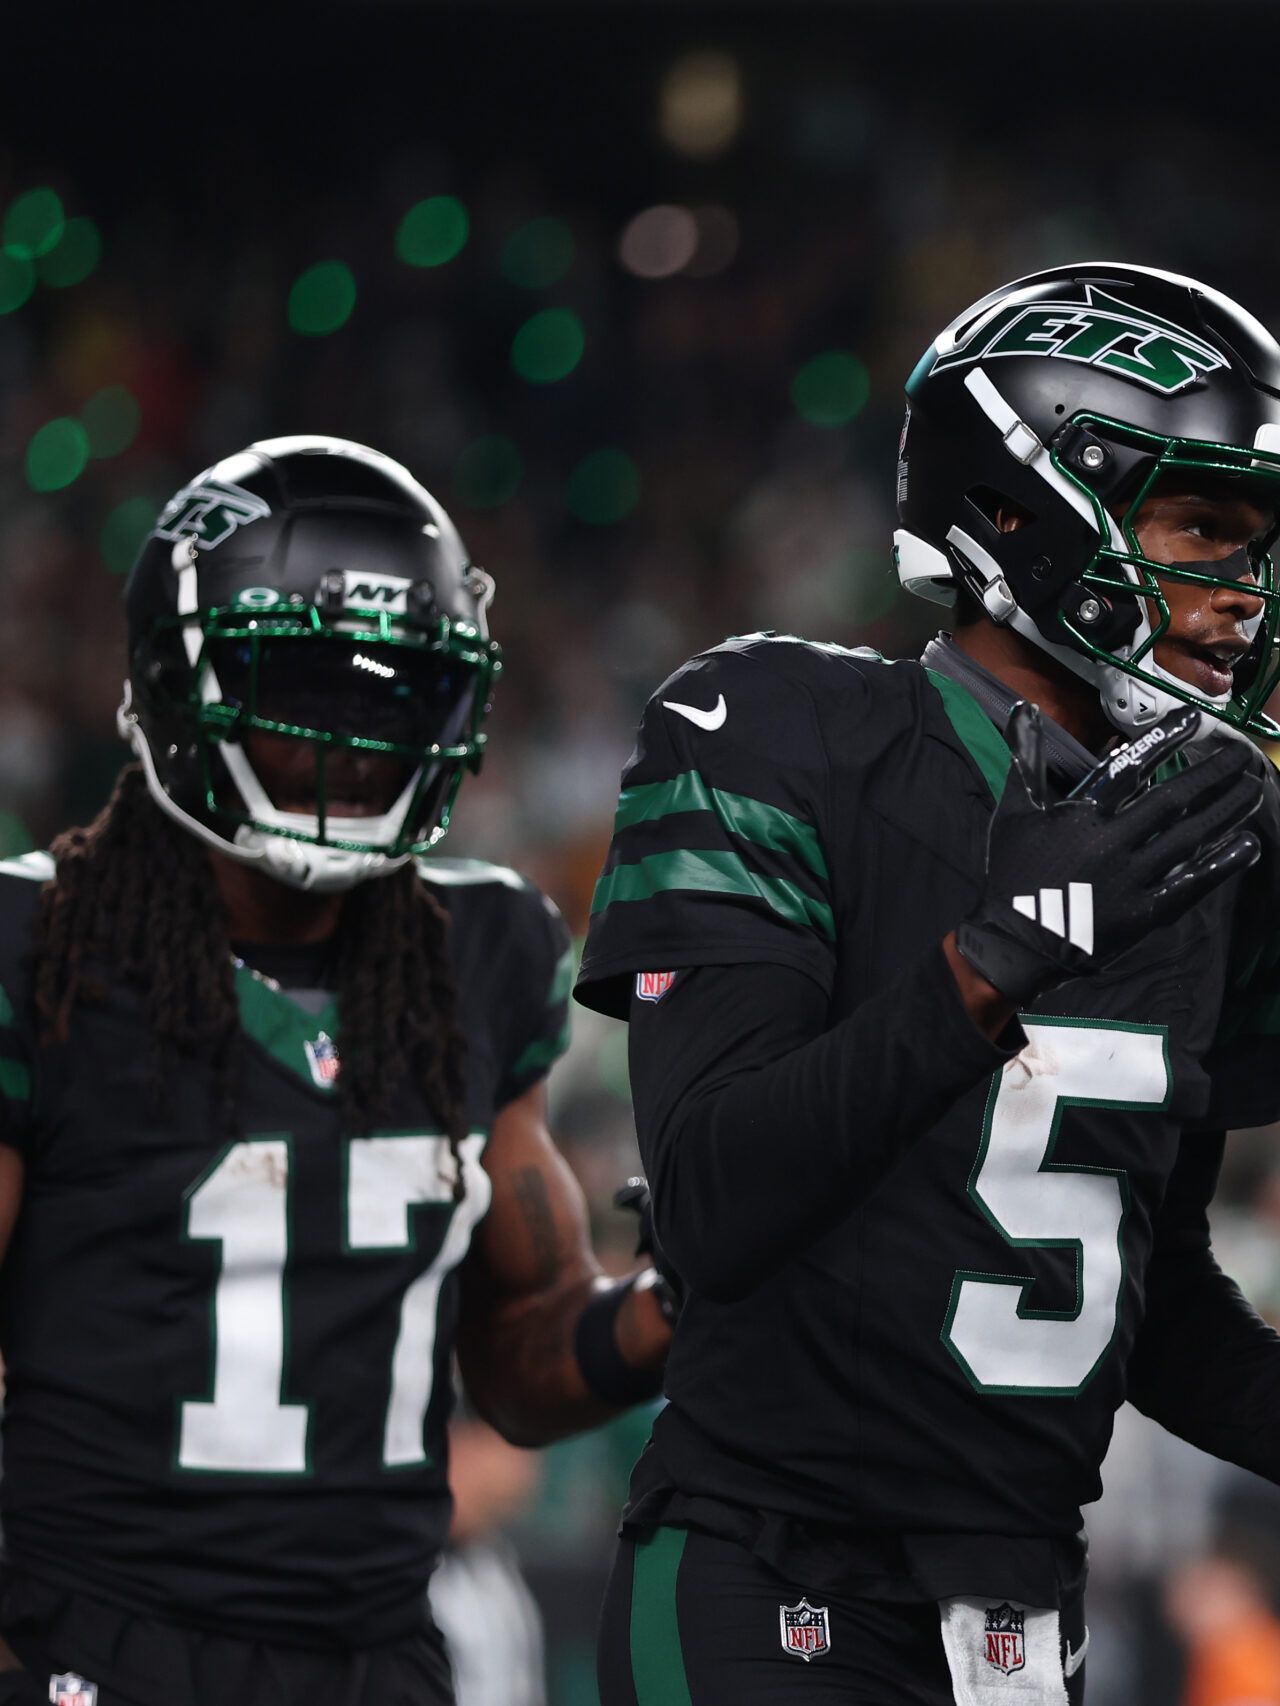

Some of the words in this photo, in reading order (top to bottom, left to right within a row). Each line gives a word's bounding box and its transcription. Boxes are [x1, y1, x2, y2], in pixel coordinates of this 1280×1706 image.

[929, 285, 1232, 393] JETS
[348, 584, 408, 602] NY
[1108, 727, 1165, 779] ADIZERO
[939, 1013, 1174, 1396] 5
[175, 1129, 494, 1474] 17
[790, 1627, 825, 1649] NFL
[985, 1633, 1022, 1668] NFL
